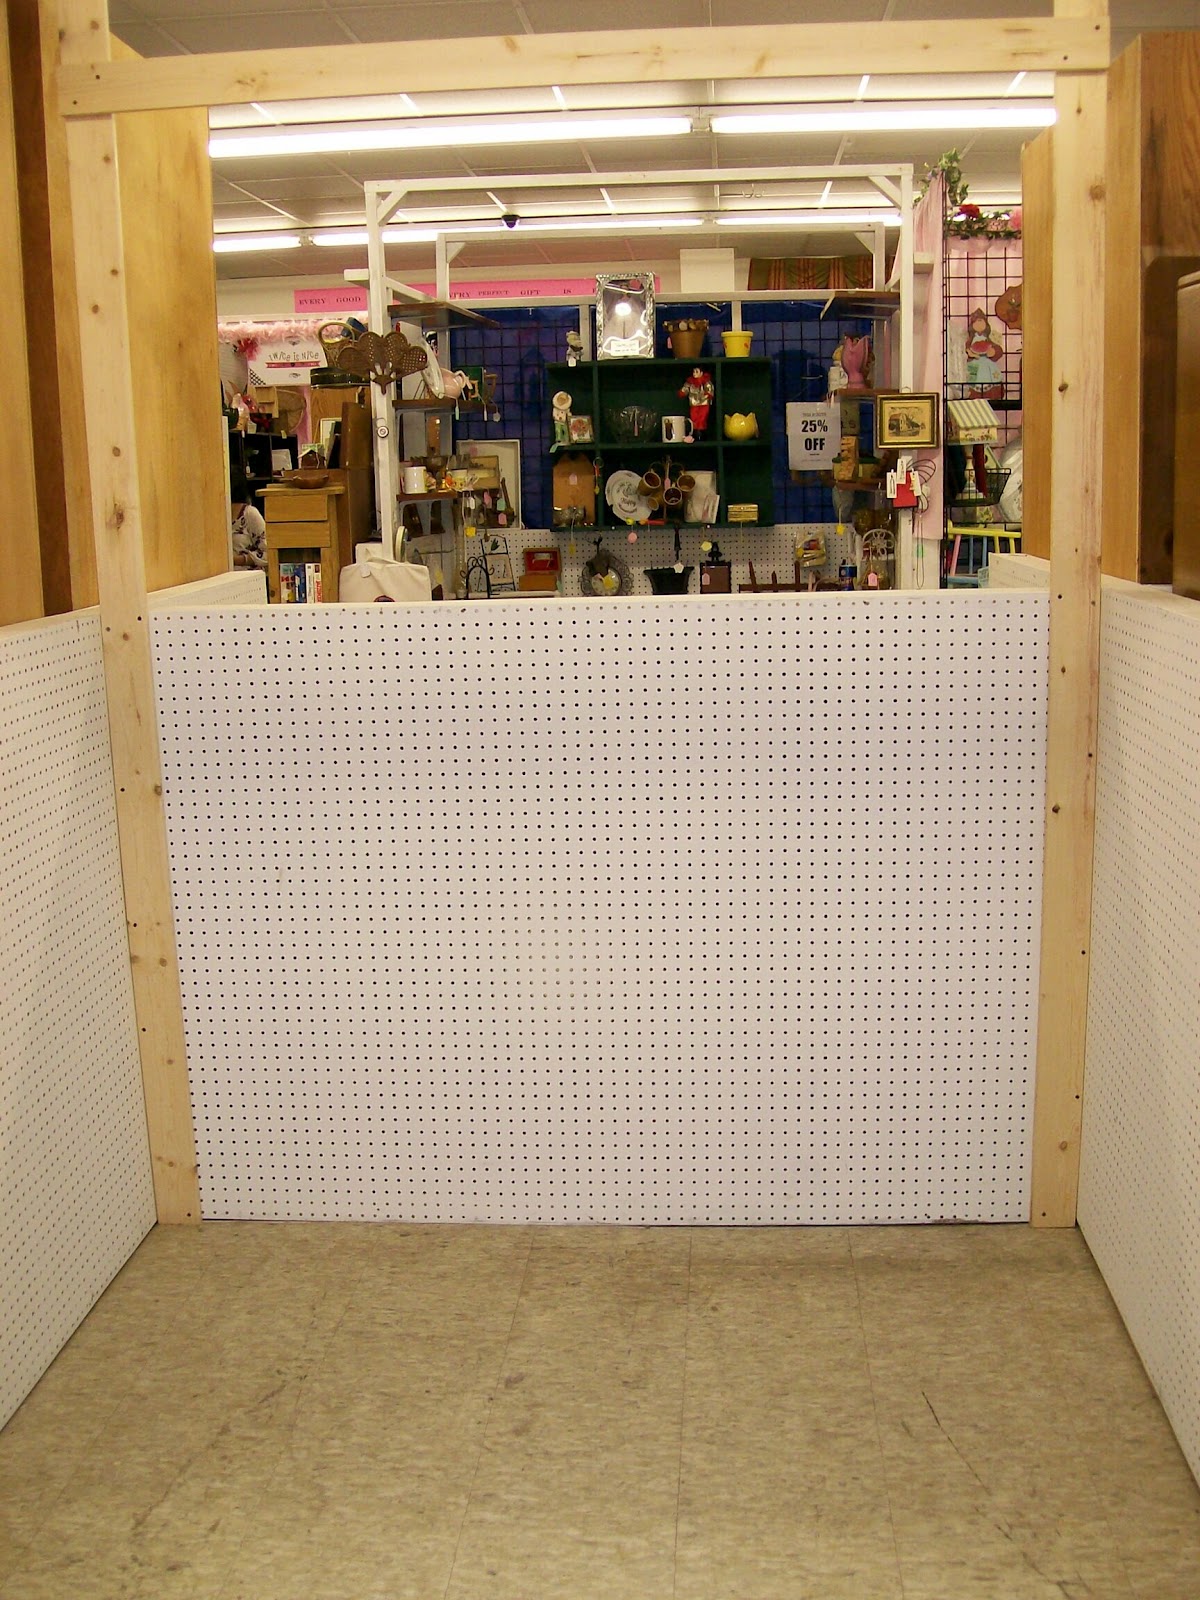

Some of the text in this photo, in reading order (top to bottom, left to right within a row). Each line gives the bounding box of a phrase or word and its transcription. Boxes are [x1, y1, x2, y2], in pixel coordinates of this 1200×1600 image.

[299, 297, 326, 305] EVERY
[801, 419, 828, 433] 25%
[804, 437, 826, 451] OFF
